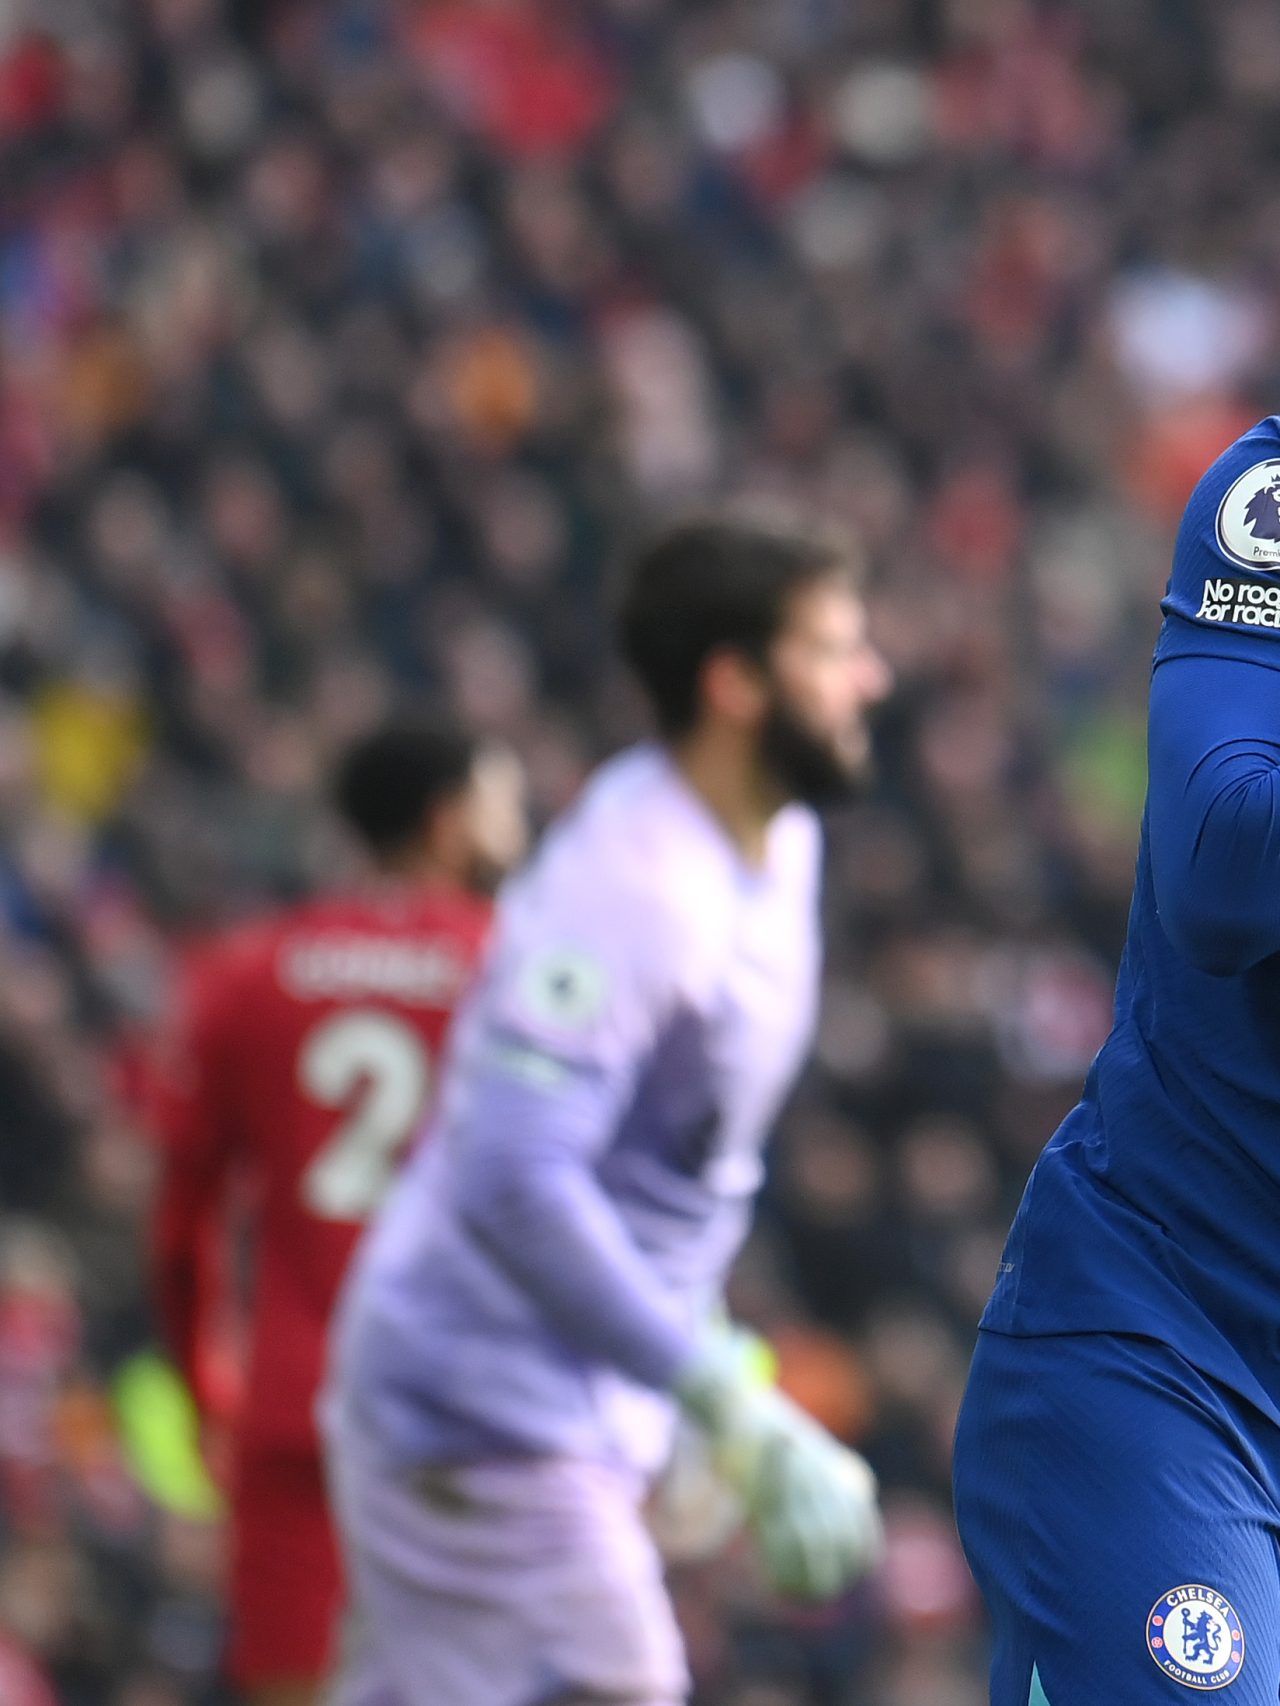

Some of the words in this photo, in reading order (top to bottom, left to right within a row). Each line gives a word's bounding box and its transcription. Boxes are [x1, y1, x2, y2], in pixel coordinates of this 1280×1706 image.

[1204, 579, 1234, 602] No
[301, 1011, 426, 1220] 2
[1166, 1588, 1229, 1617] CHELSEA
[1164, 1660, 1207, 1684] FOOTBALL
[1210, 1670, 1230, 1684] CLUB
